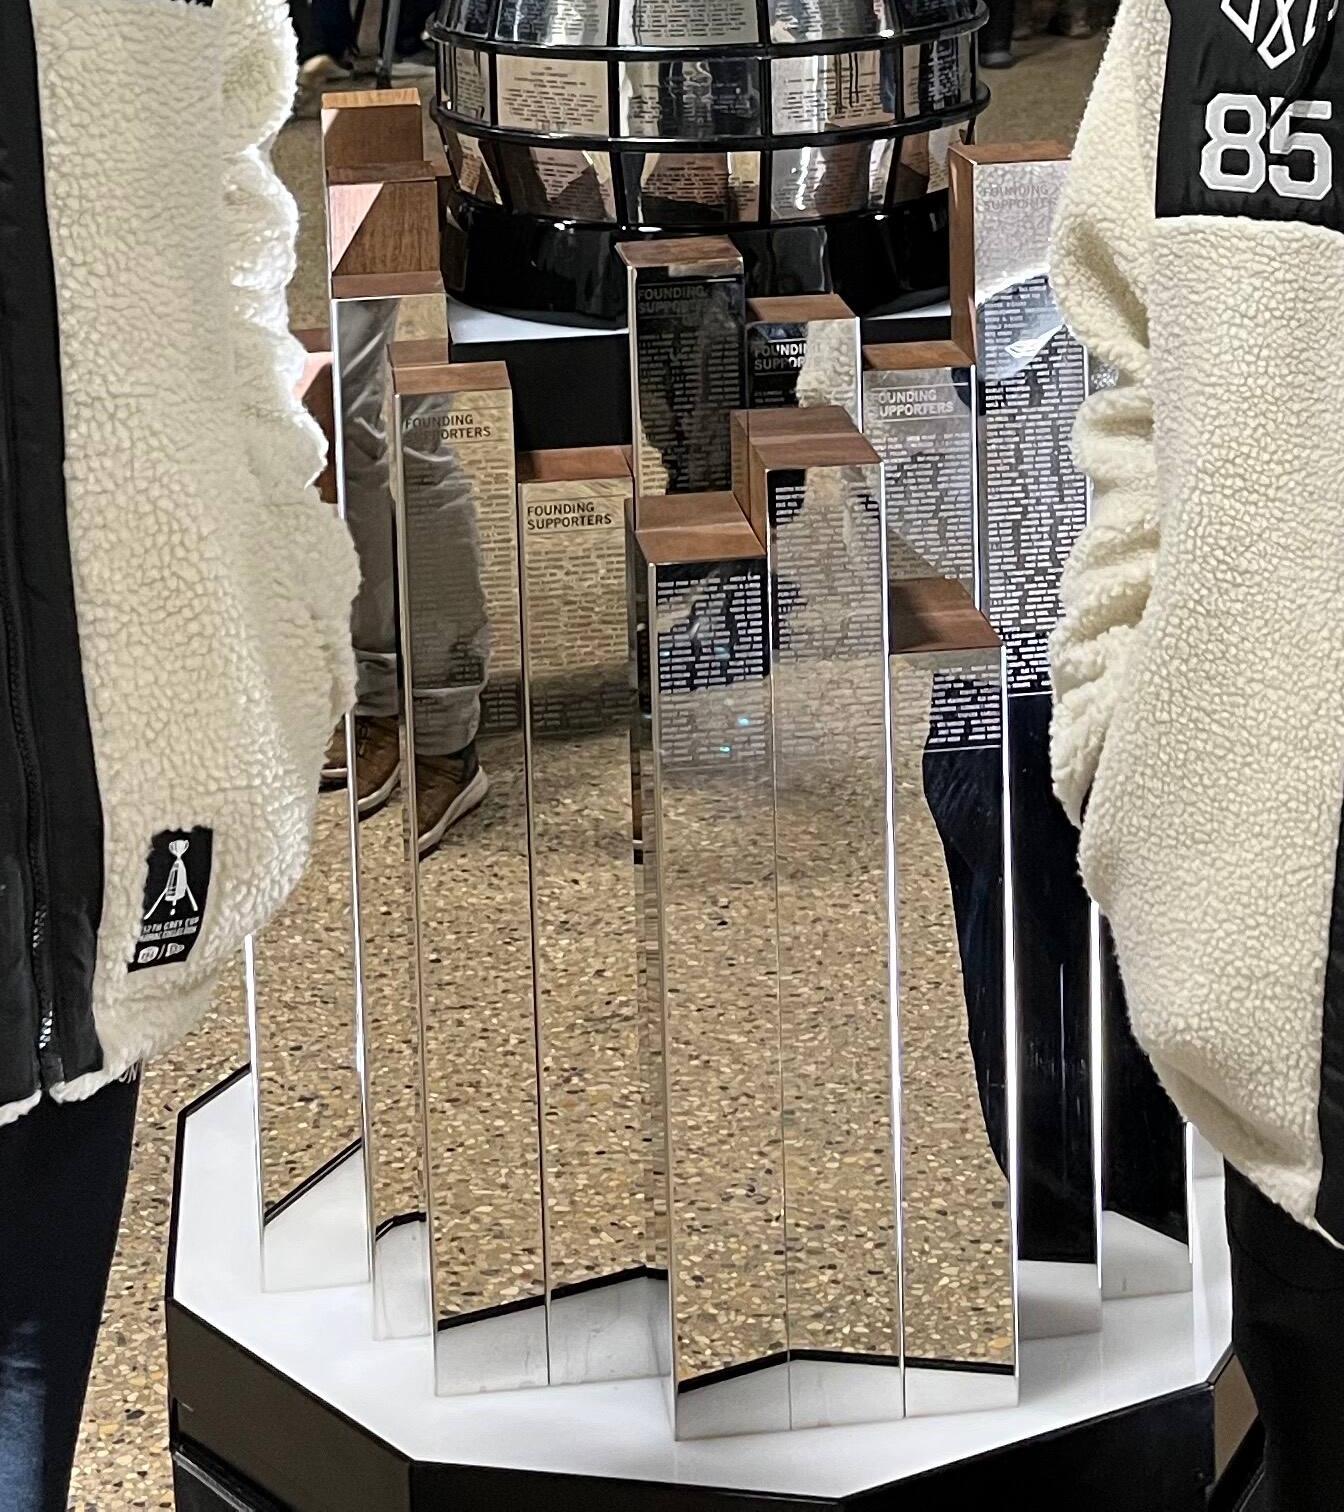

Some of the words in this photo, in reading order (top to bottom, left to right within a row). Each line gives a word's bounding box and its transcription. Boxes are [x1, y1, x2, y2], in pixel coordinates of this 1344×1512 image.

[1199, 92, 1333, 201] 85
[754, 342, 807, 357] FOUNDI
[877, 388, 937, 404] OUNDING
[878, 400, 955, 417] UPPORTERS
[405, 413, 474, 430] FOUNDING
[527, 501, 595, 518] FOUNDING
[527, 513, 613, 531] SUPPORTERS
